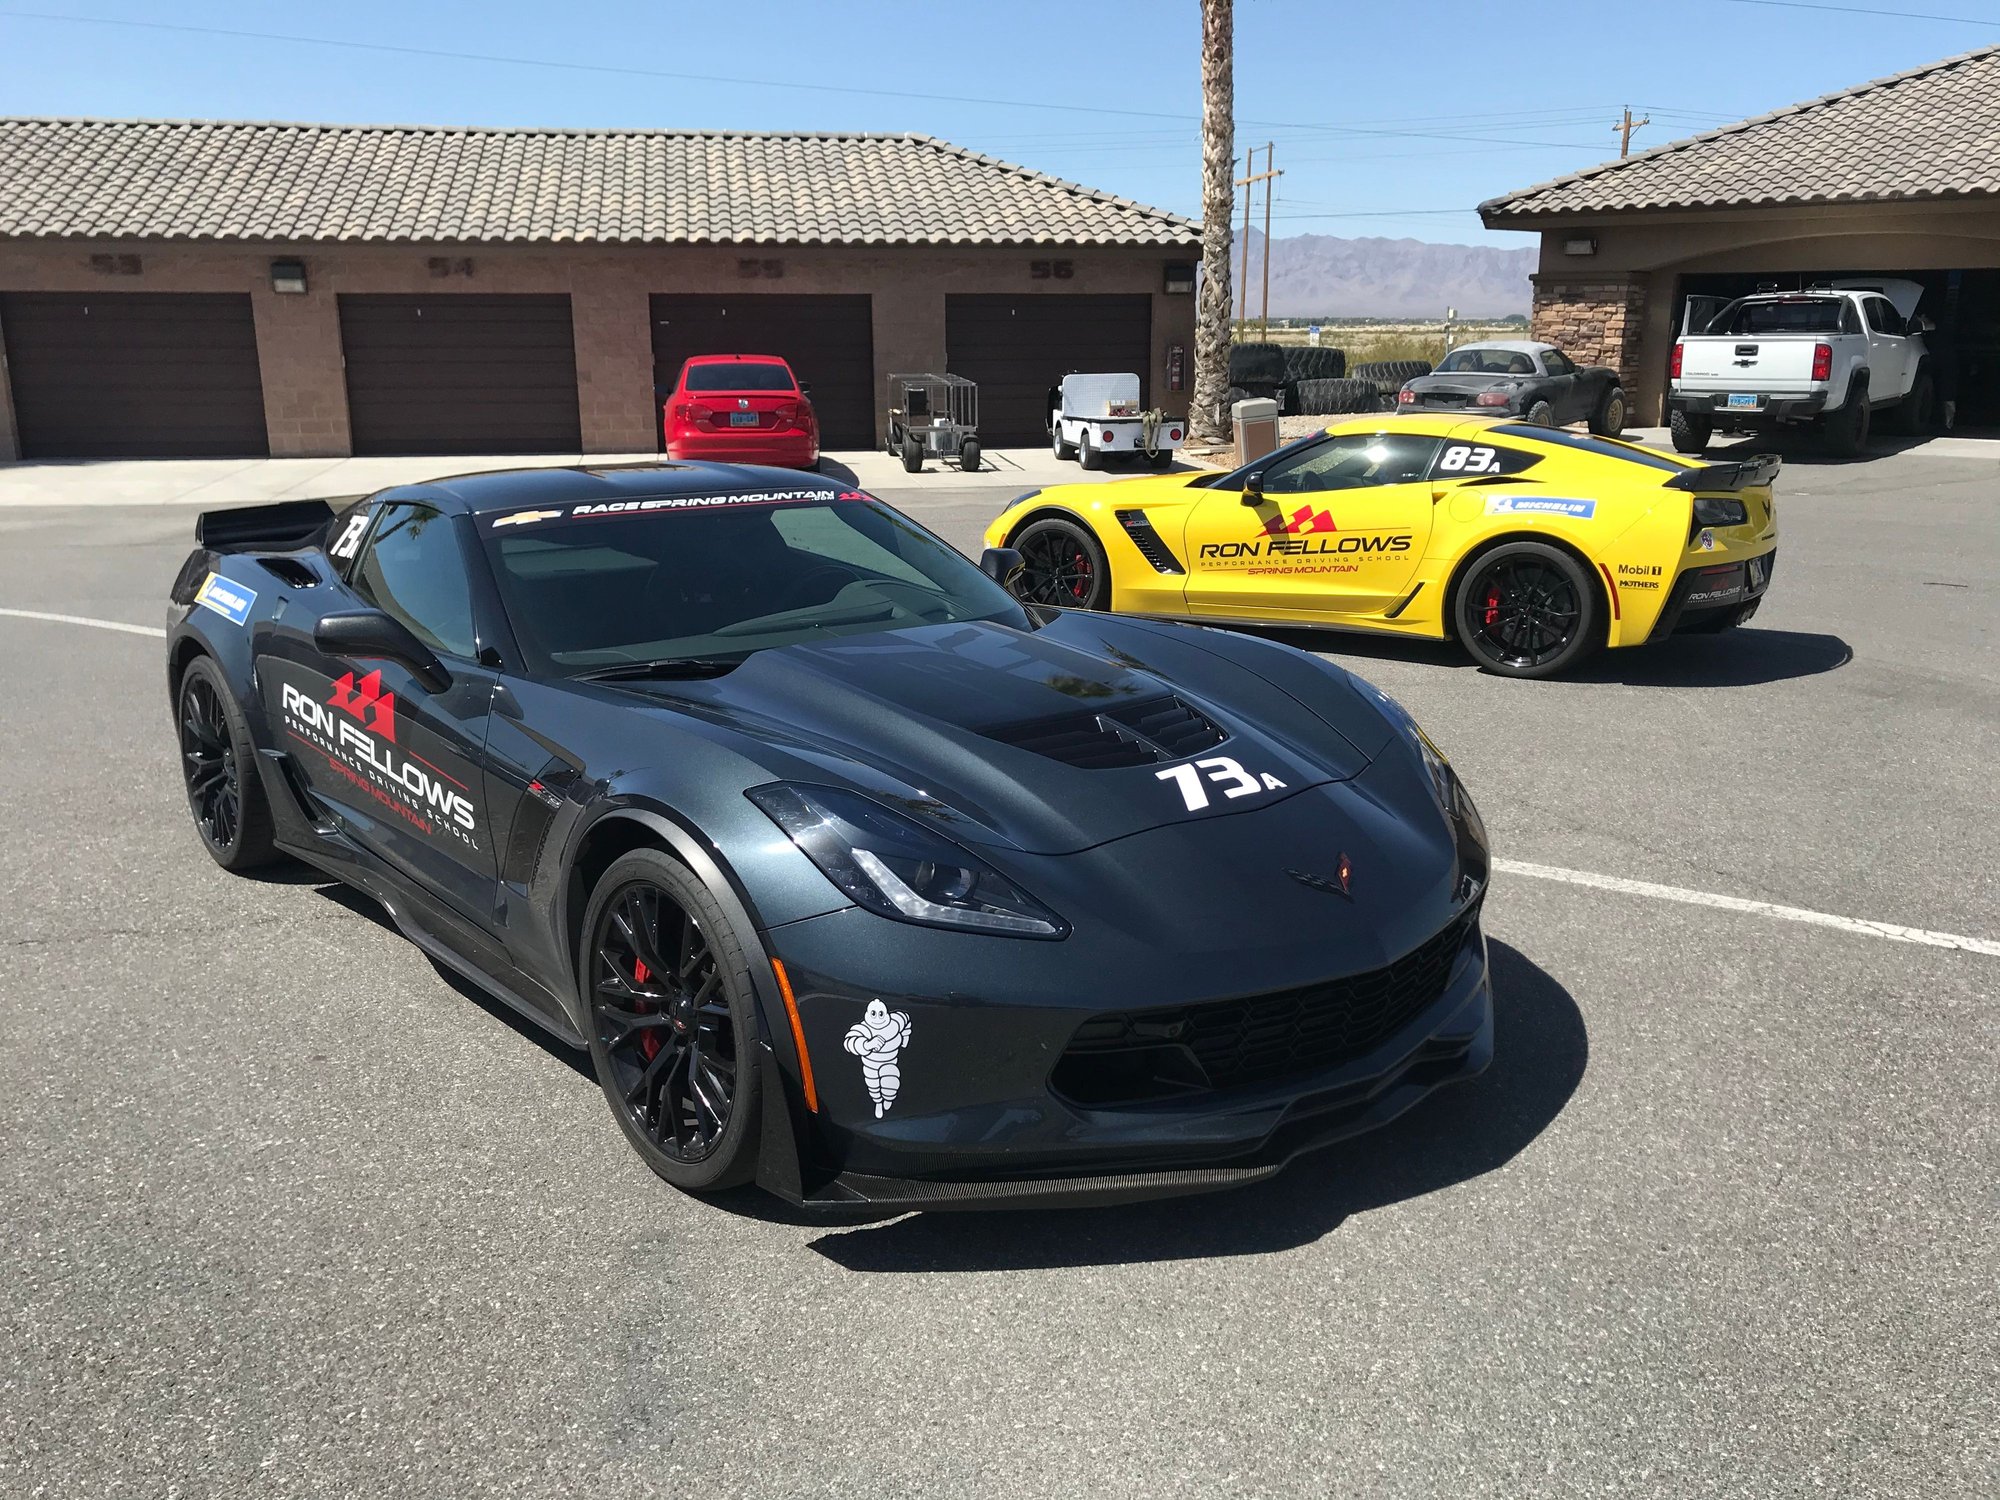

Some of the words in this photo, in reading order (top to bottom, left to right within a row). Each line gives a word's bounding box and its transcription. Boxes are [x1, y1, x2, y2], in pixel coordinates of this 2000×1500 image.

[1030, 260, 1074, 279] 56
[1515, 501, 1586, 513] MICHELIN
[1200, 542, 1260, 559] RON
[1267, 535, 1413, 556] FELLOWS
[1200, 558, 1288, 567] PERFORMANCE
[1297, 556, 1349, 564] DRIVING
[1358, 554, 1409, 562] SCHOOL
[1247, 566, 1293, 575] SPRING
[1294, 564, 1359, 574] MOUNTAIN
[1618, 564, 1649, 575] Mobil
[1619, 580, 1659, 589] MOTHERS
[1688, 592, 1710, 600] RON
[1709, 585, 1741, 598] FELLOWS
[282, 682, 334, 738] RON
[339, 718, 475, 830] FELLOWS
[284, 715, 362, 771] PERFORMANCE
[368, 769, 419, 810] DRIVING
[426, 808, 479, 851] SCHOOL
[328, 756, 370, 793] SPRING
[371, 785, 432, 835] MOUNTAIN
